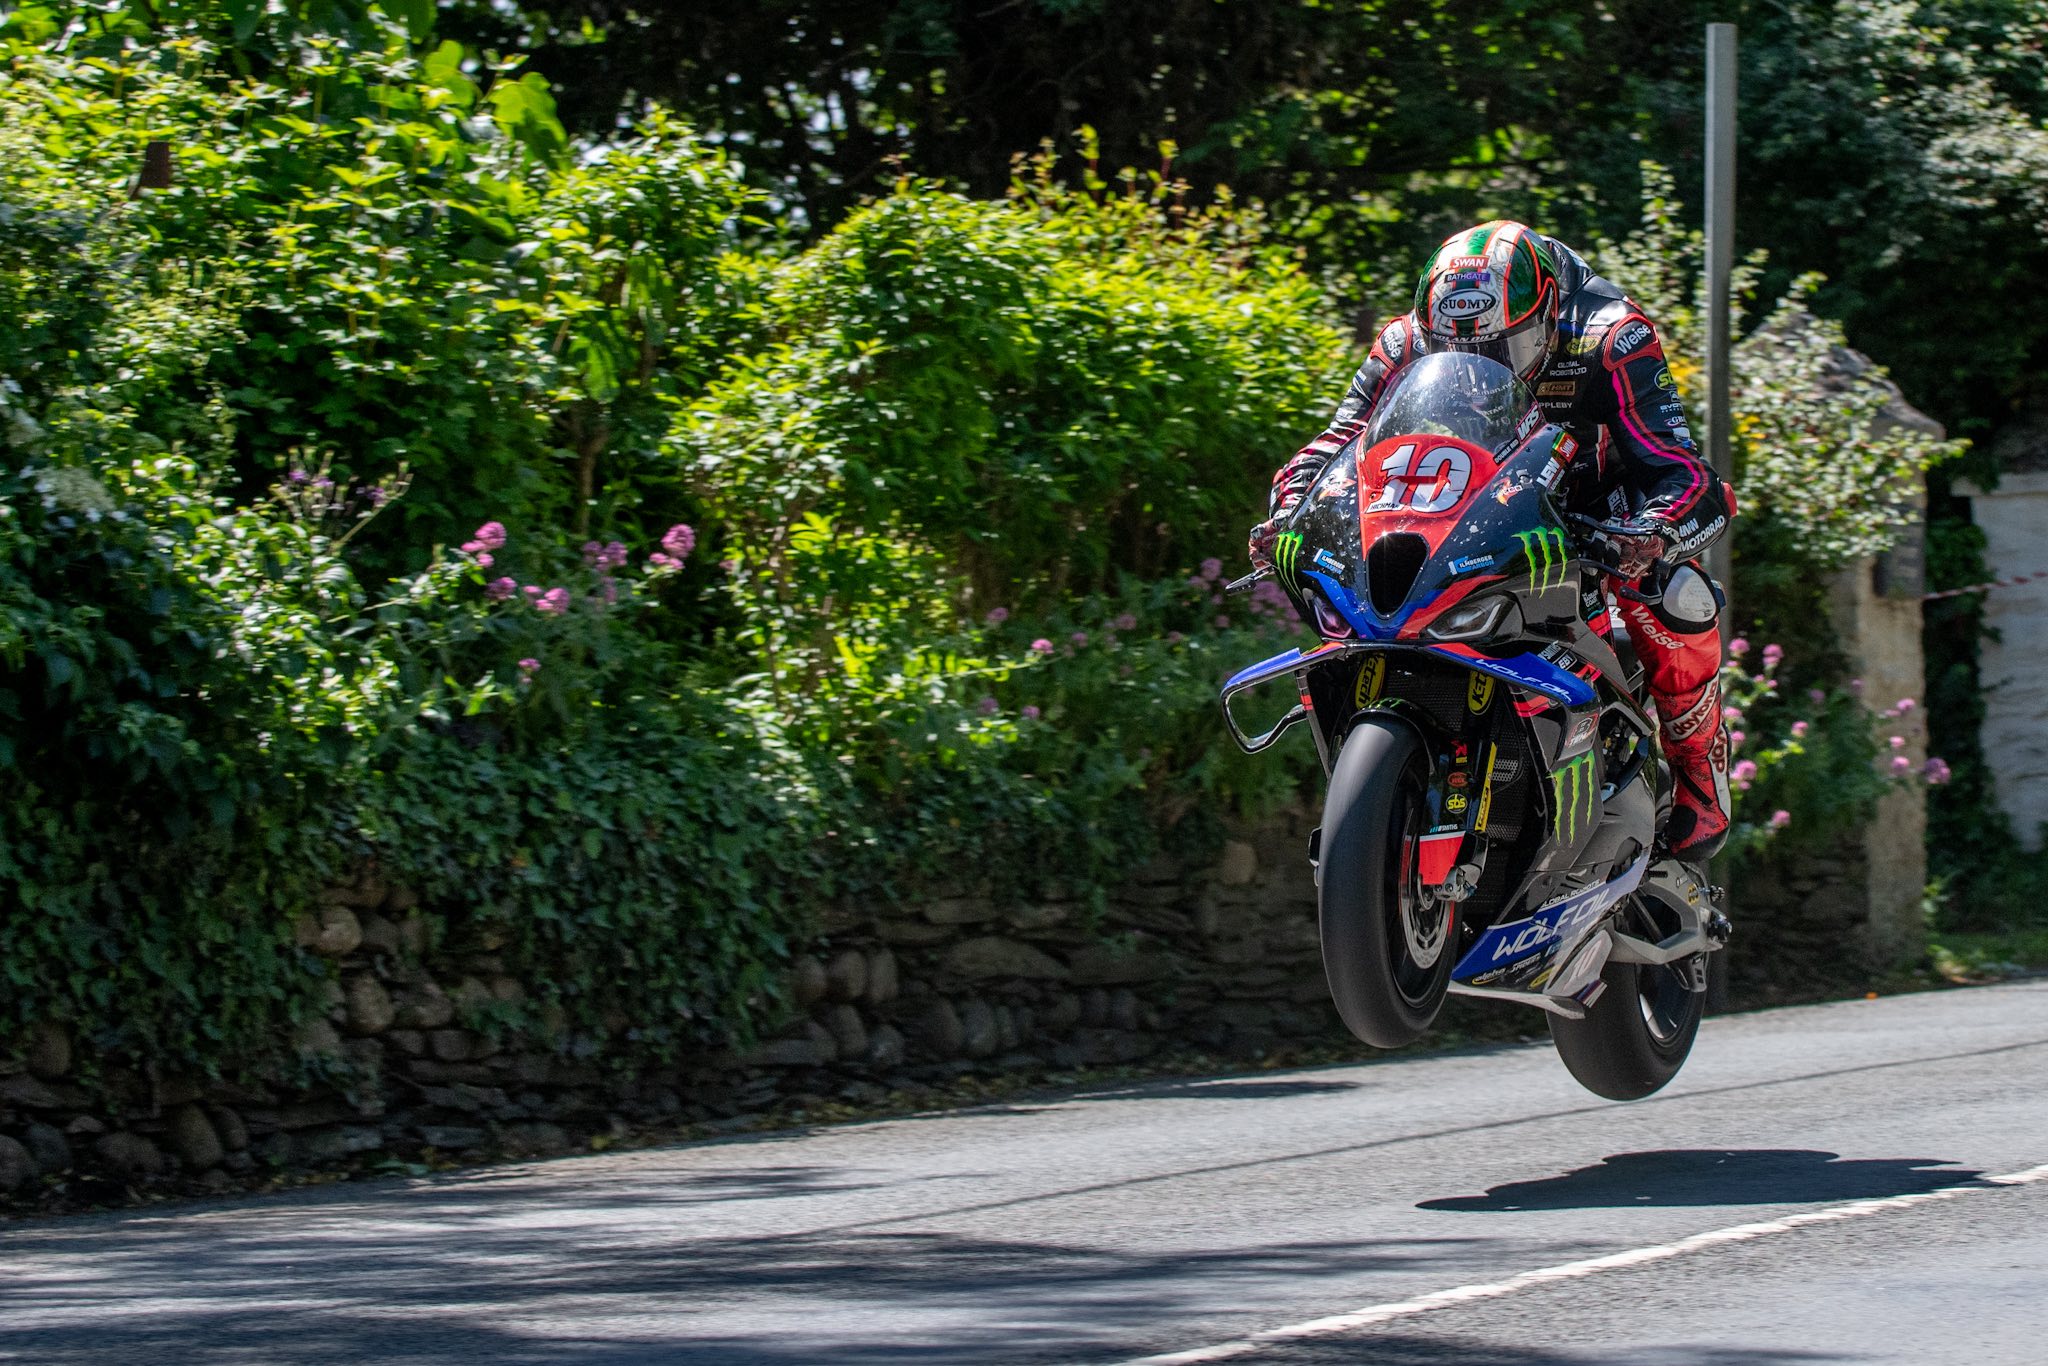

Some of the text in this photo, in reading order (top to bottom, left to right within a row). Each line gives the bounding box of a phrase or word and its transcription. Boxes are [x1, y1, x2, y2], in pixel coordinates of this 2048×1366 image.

[1453, 258, 1485, 268] SWAN
[1442, 299, 1490, 309] SUOMY
[1384, 330, 1402, 358] eise
[1614, 324, 1651, 355] Weise
[1365, 444, 1472, 513] 10
[1679, 515, 1725, 552] MOTORRAD
[1631, 605, 1687, 650] Weise
[1673, 681, 1718, 735] daytona
[1447, 794, 1466, 810] sbs
